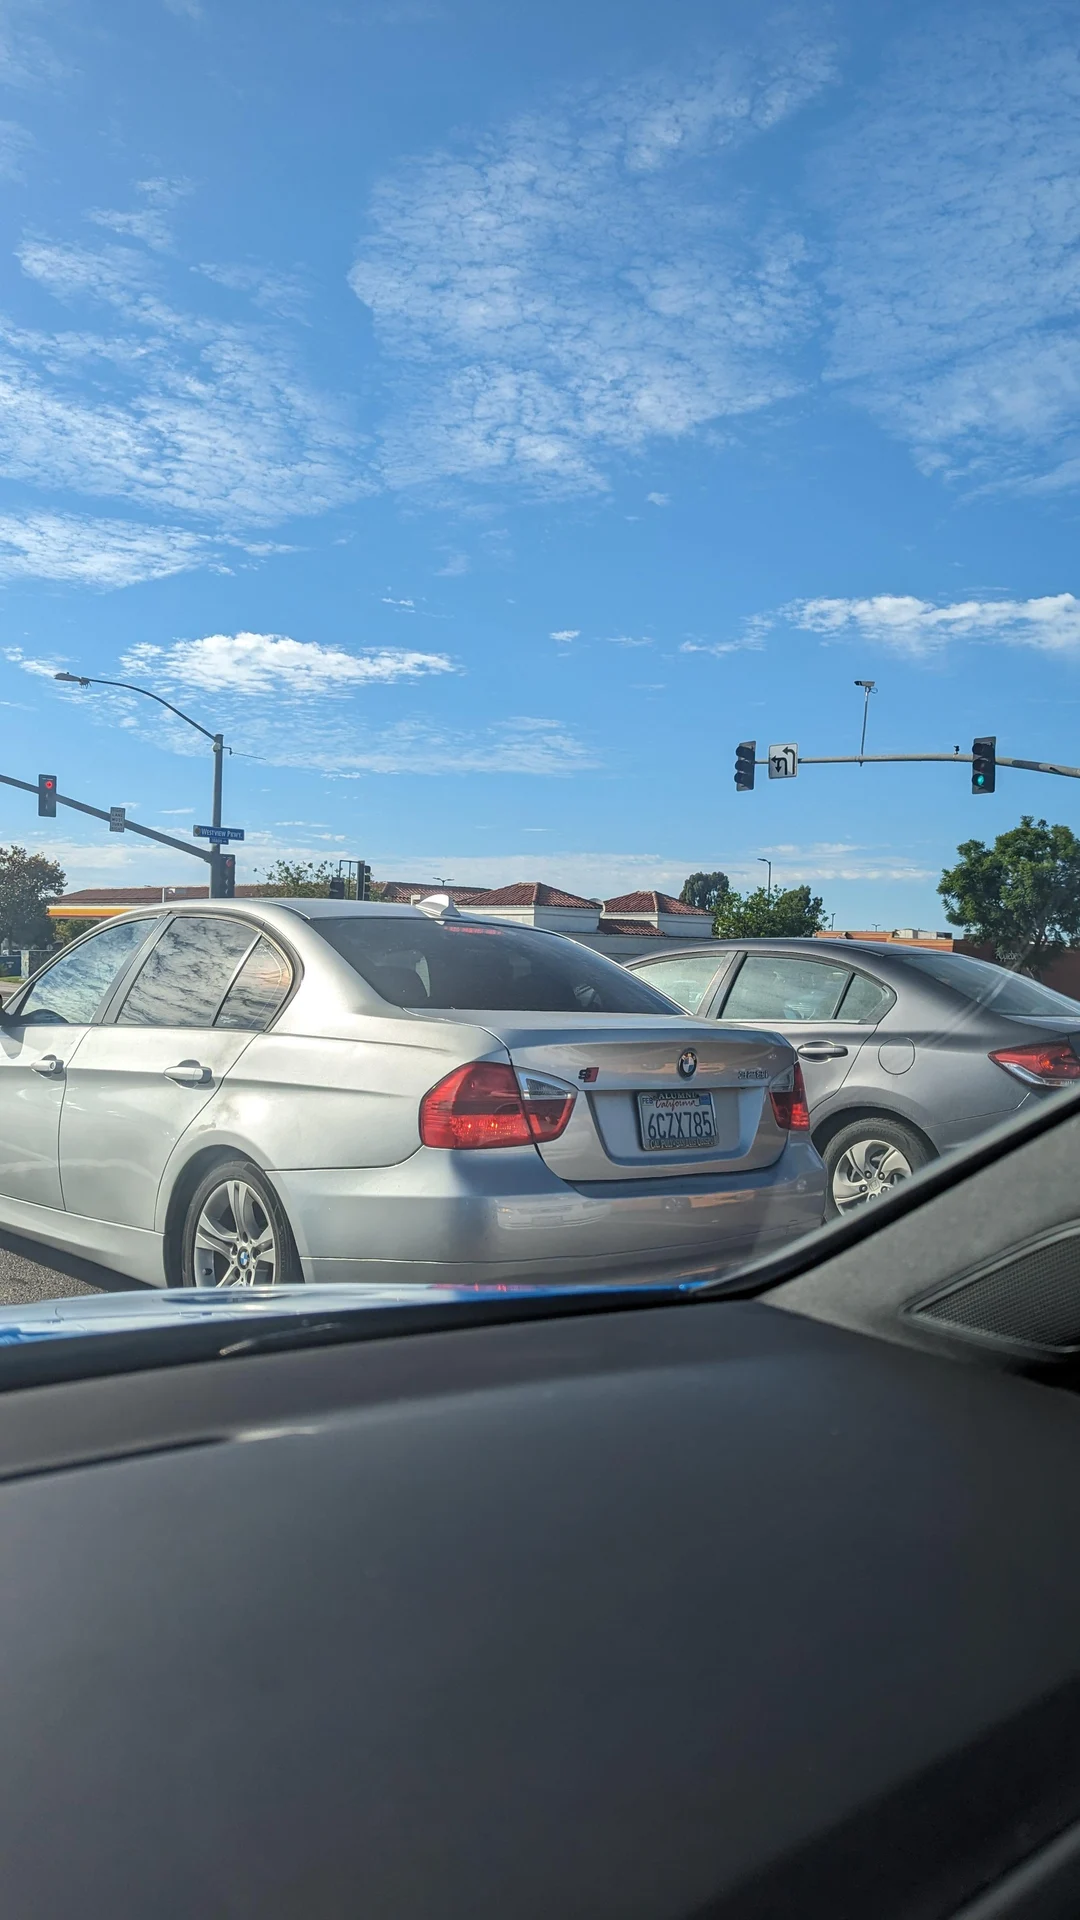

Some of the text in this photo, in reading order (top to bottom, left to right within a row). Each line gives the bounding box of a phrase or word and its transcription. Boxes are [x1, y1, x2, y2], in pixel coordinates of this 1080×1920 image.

[201, 828, 226, 837] WESTVIEW
[659, 1091, 697, 1100] ALUMNI
[642, 1097, 654, 1105] FEB
[655, 1100, 698, 1111] California
[648, 1111, 712, 1139] 6CZX785
